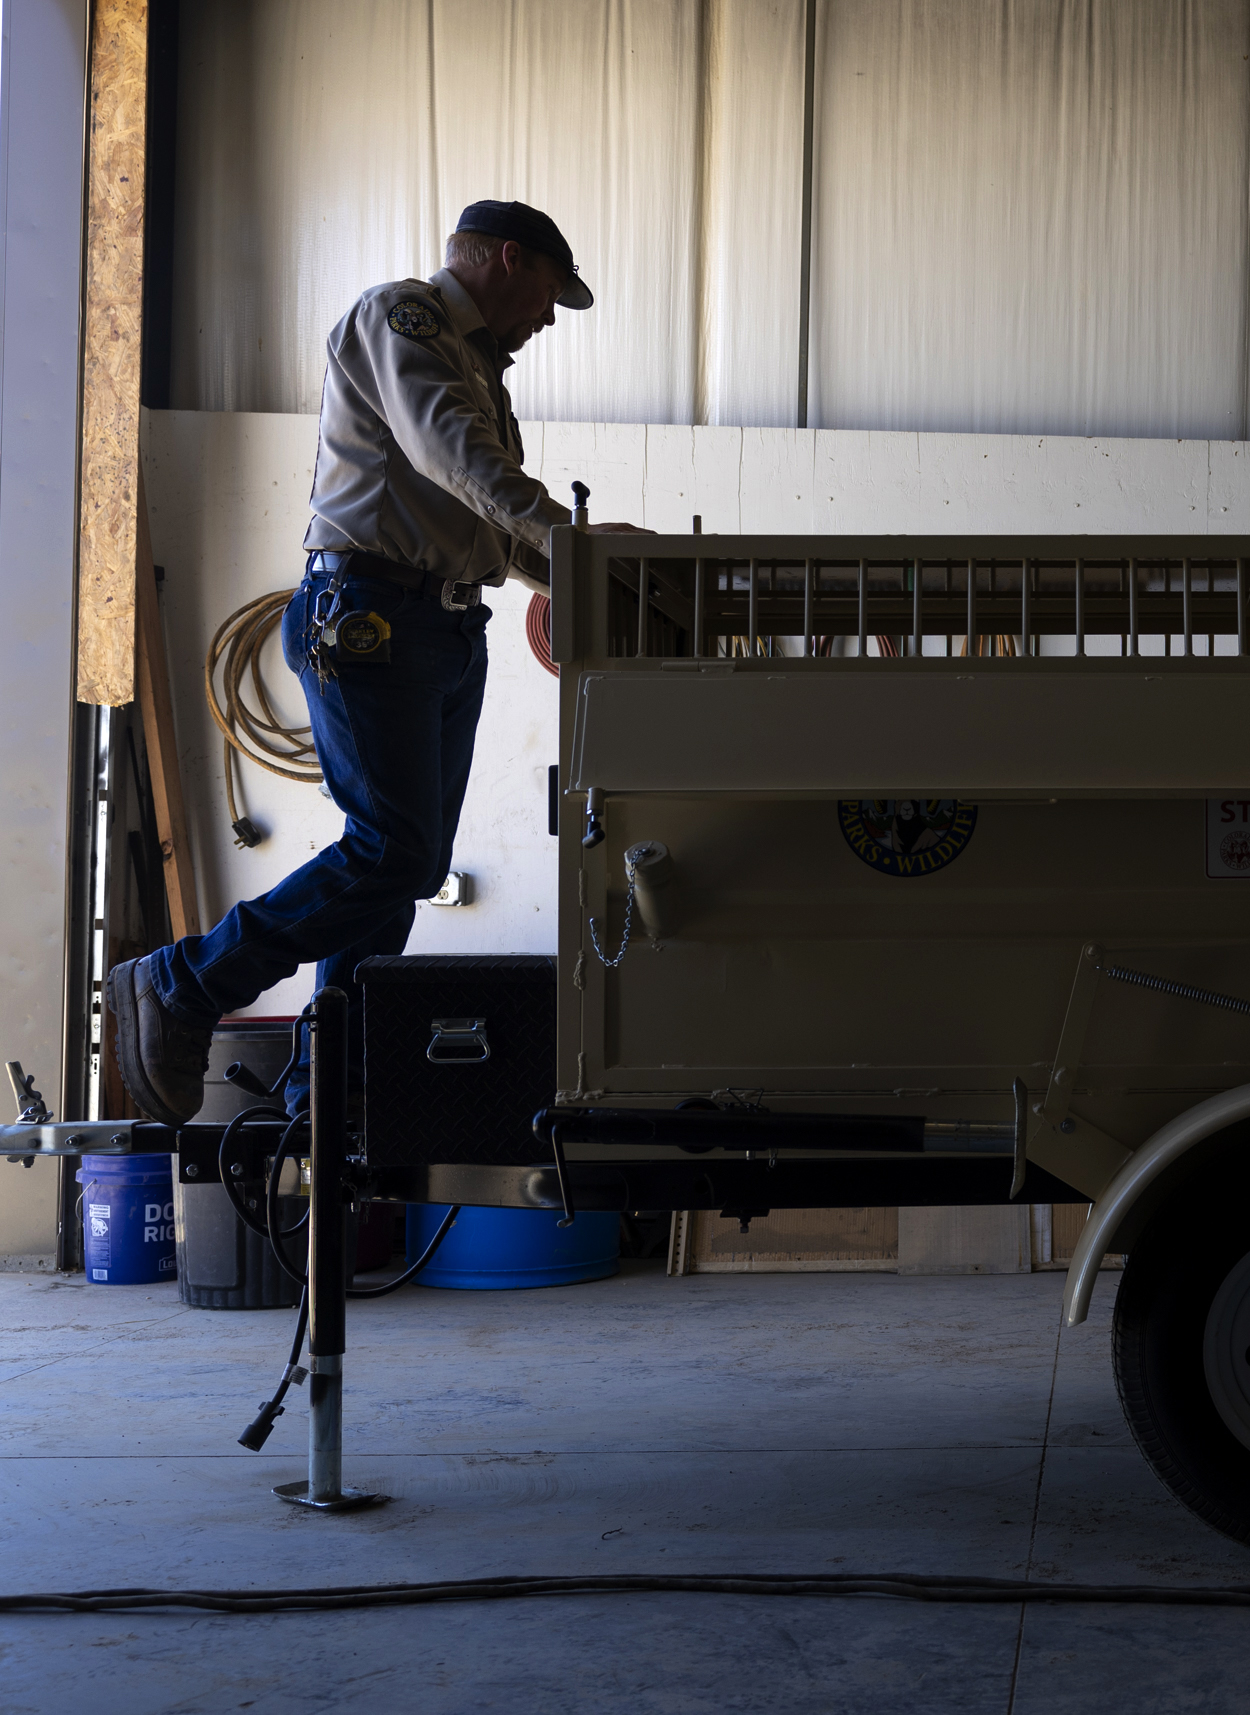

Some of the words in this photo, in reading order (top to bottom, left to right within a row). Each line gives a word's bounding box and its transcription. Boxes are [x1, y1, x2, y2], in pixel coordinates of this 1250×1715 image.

[392, 301, 435, 319] COLORADO
[389, 316, 406, 334] PARKS
[841, 800, 882, 863] PARKS
[143, 1225, 176, 1243] RIG
